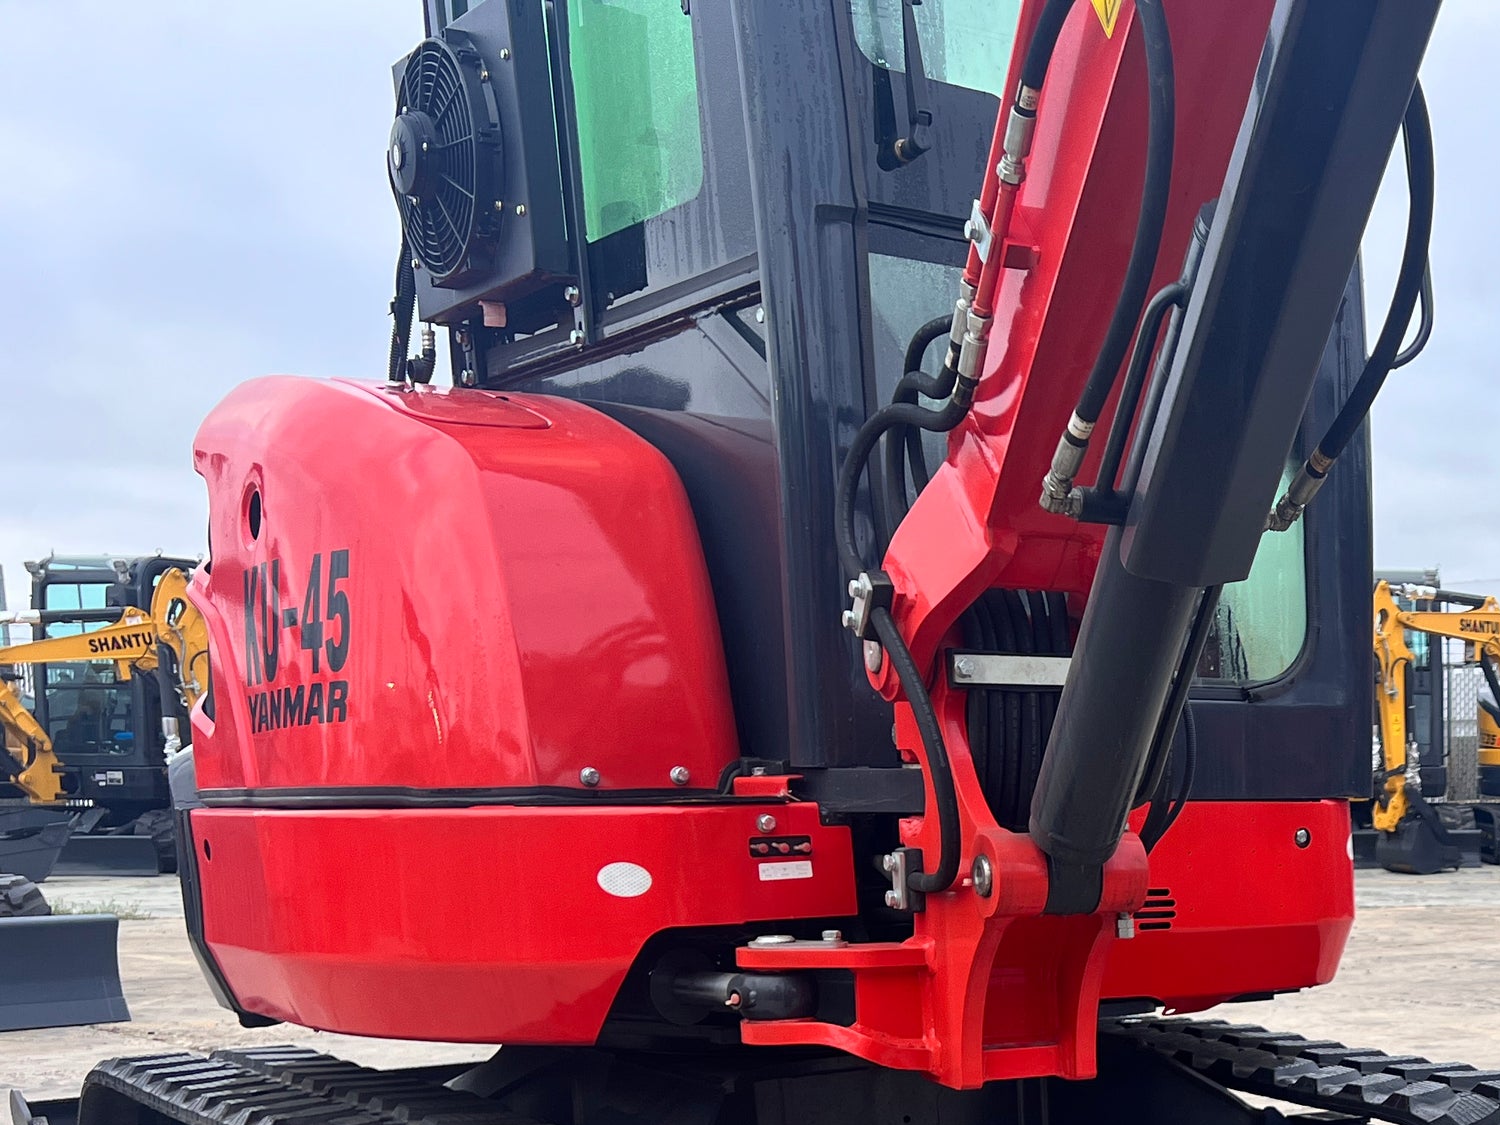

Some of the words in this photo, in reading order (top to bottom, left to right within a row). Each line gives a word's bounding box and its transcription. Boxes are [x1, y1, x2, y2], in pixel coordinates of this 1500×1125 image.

[88, 632, 153, 653] SHANTU
[243, 549, 350, 687] KU-45
[248, 680, 349, 734] YANMAR
